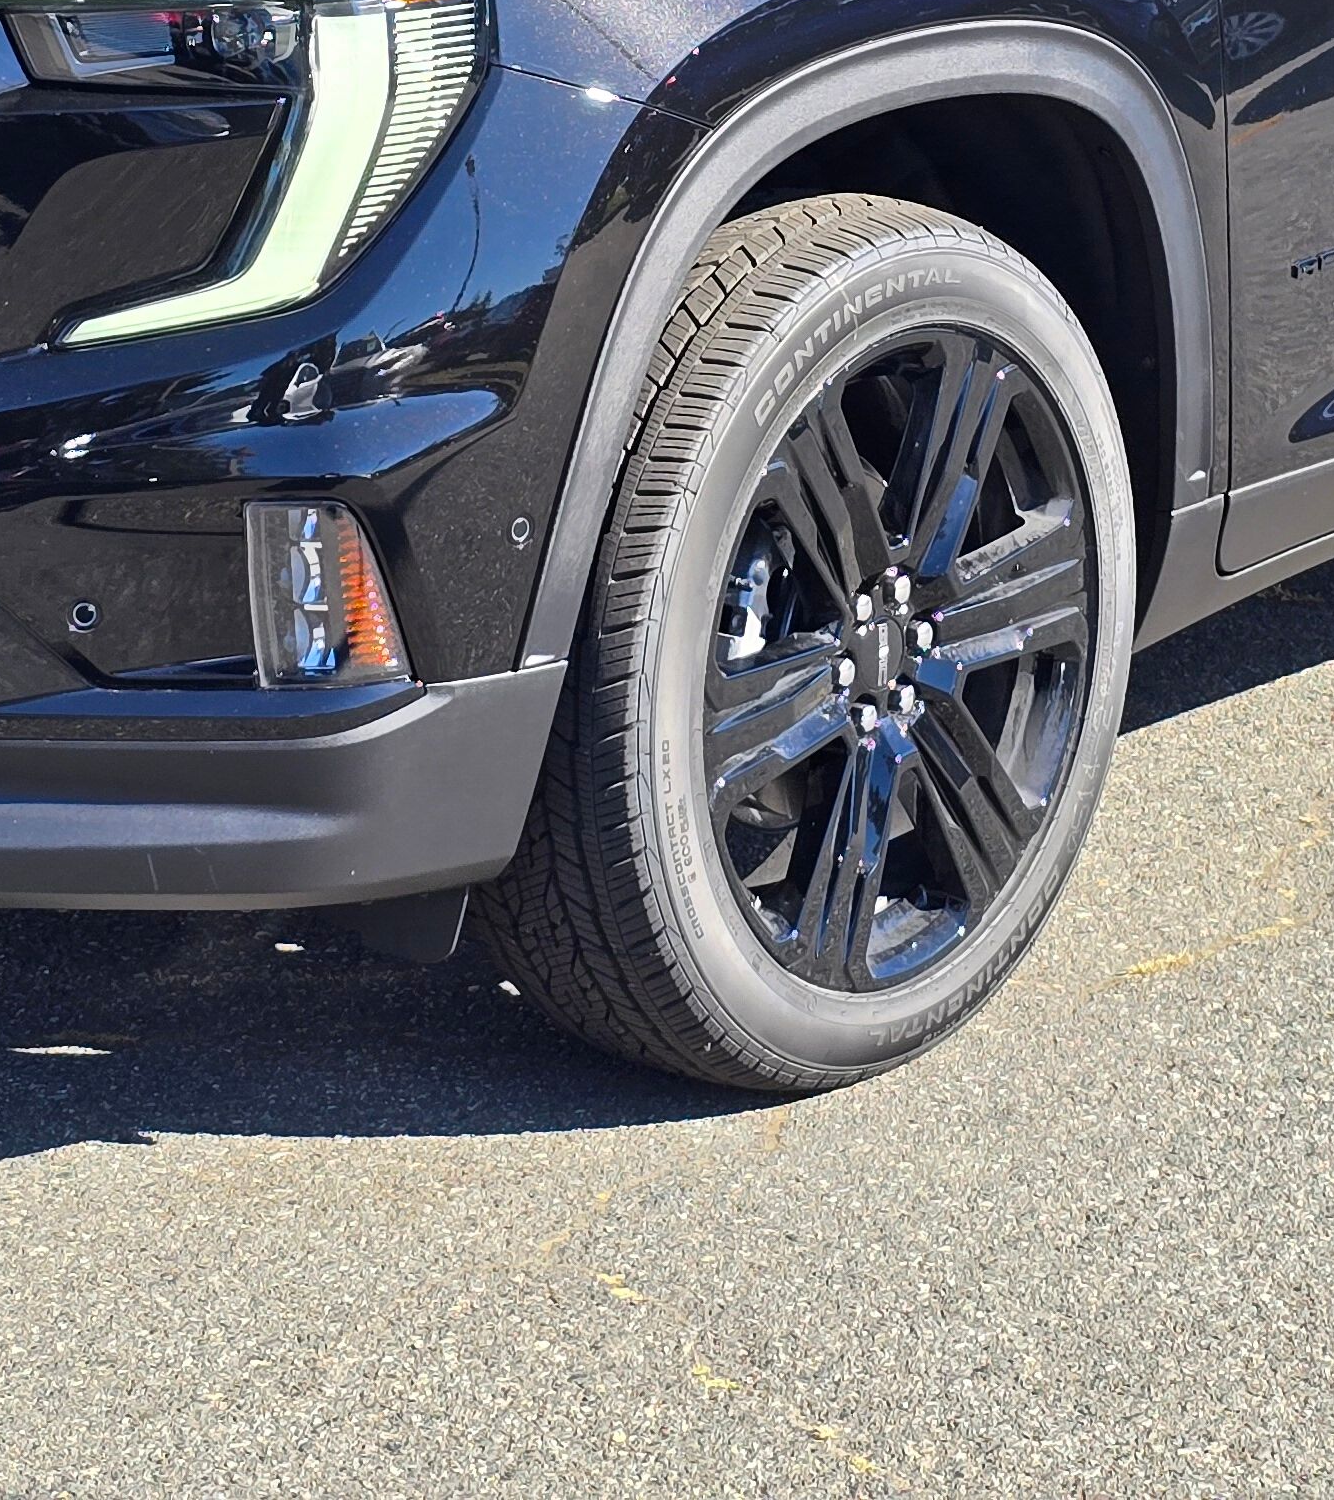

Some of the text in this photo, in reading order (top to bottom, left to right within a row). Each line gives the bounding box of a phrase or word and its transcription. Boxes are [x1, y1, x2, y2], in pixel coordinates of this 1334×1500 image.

[753, 267, 962, 429] CONTINENTAL
[663, 801, 705, 941] CROSSCONTACT
[869, 864, 1061, 1047] CONTINENTAL
